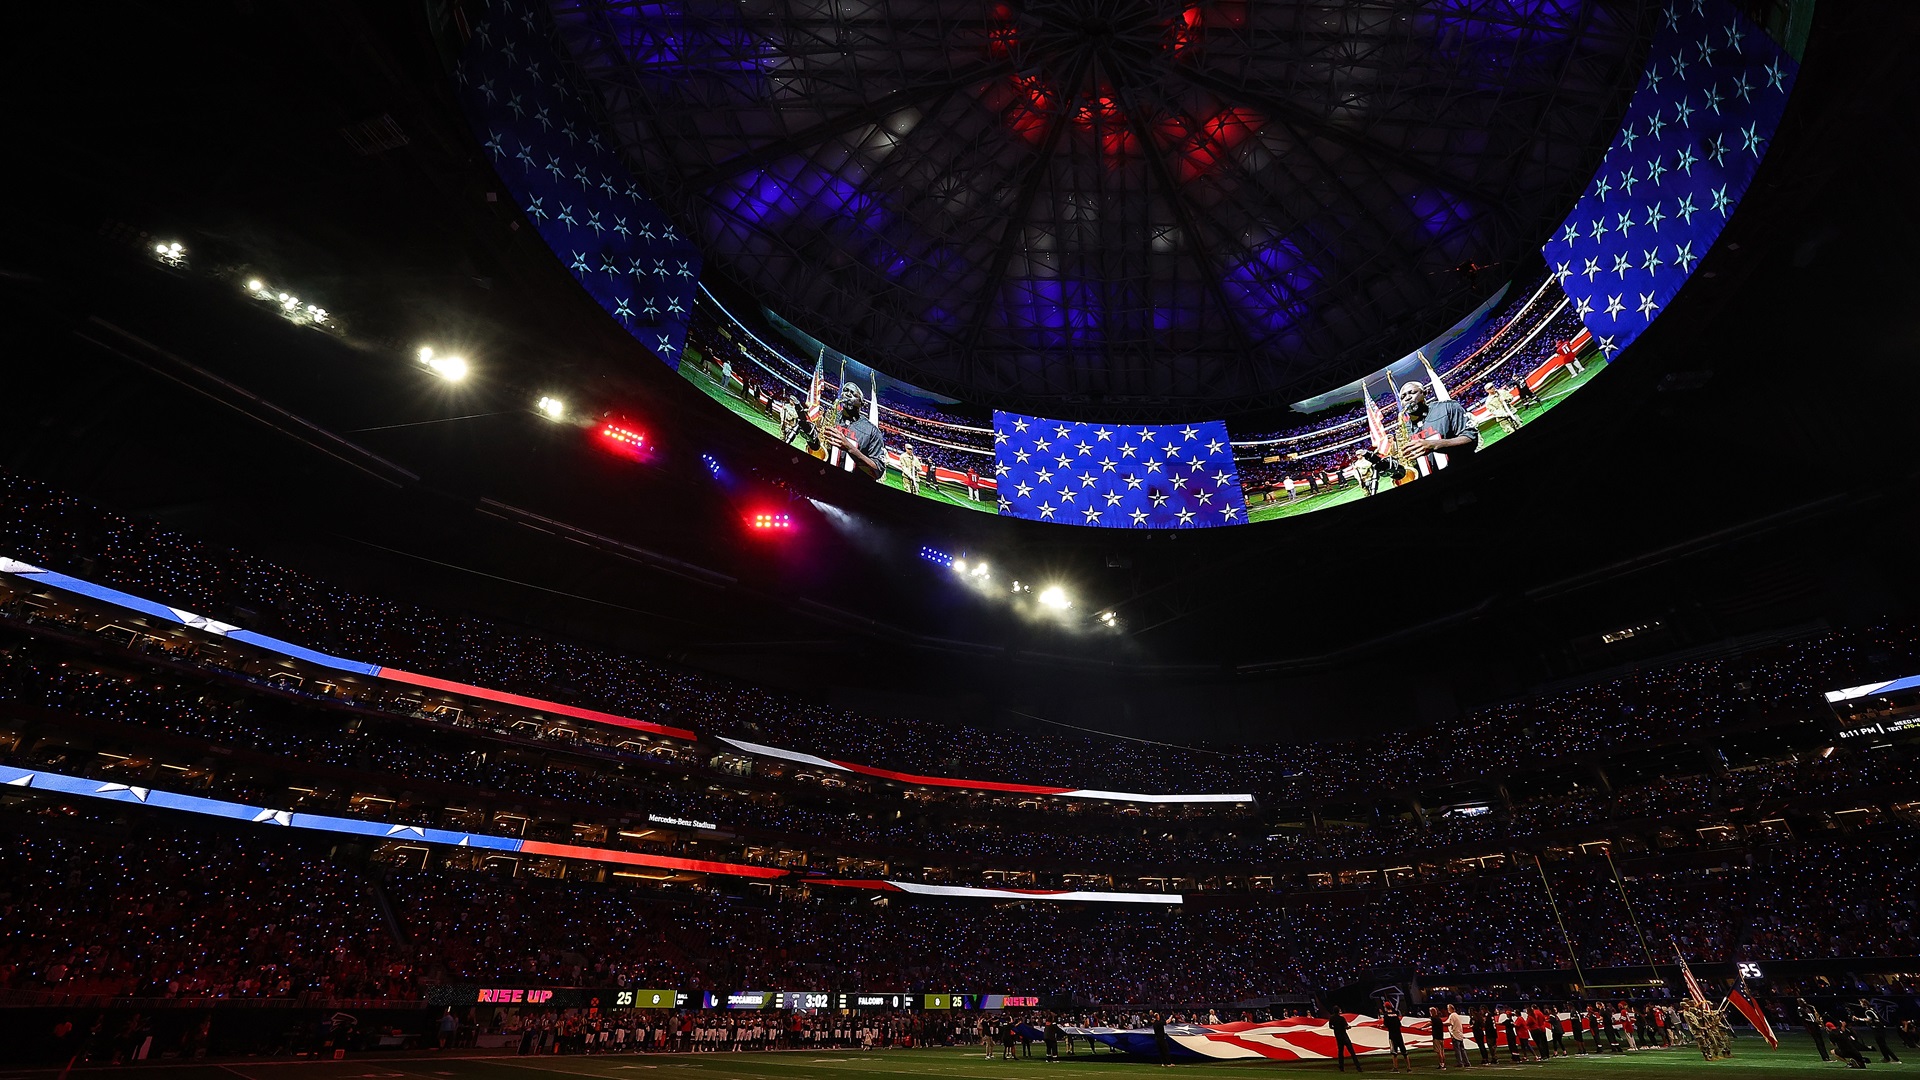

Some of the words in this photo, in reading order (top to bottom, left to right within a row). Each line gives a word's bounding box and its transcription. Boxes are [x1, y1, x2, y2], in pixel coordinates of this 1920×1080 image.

[1839, 730, 1860, 739] 8:11
[1860, 726, 1877, 735] PM
[648, 814, 692, 827] Mercedes-Benz
[692, 820, 717, 830] Stadium
[1739, 963, 1762, 978] 25
[478, 989, 524, 1002] RISE
[527, 990, 553, 1003] UP
[616, 991, 632, 1005] 25
[805, 994, 828, 1008] 3:02
[858, 996, 884, 1005] FALCONS
[893, 996, 899, 1008] 0
[952, 996, 962, 1007] 25
[1003, 997, 1025, 1006] RISE
[1026, 997, 1039, 1006] UP
[793, 1000, 798, 1008] 1
